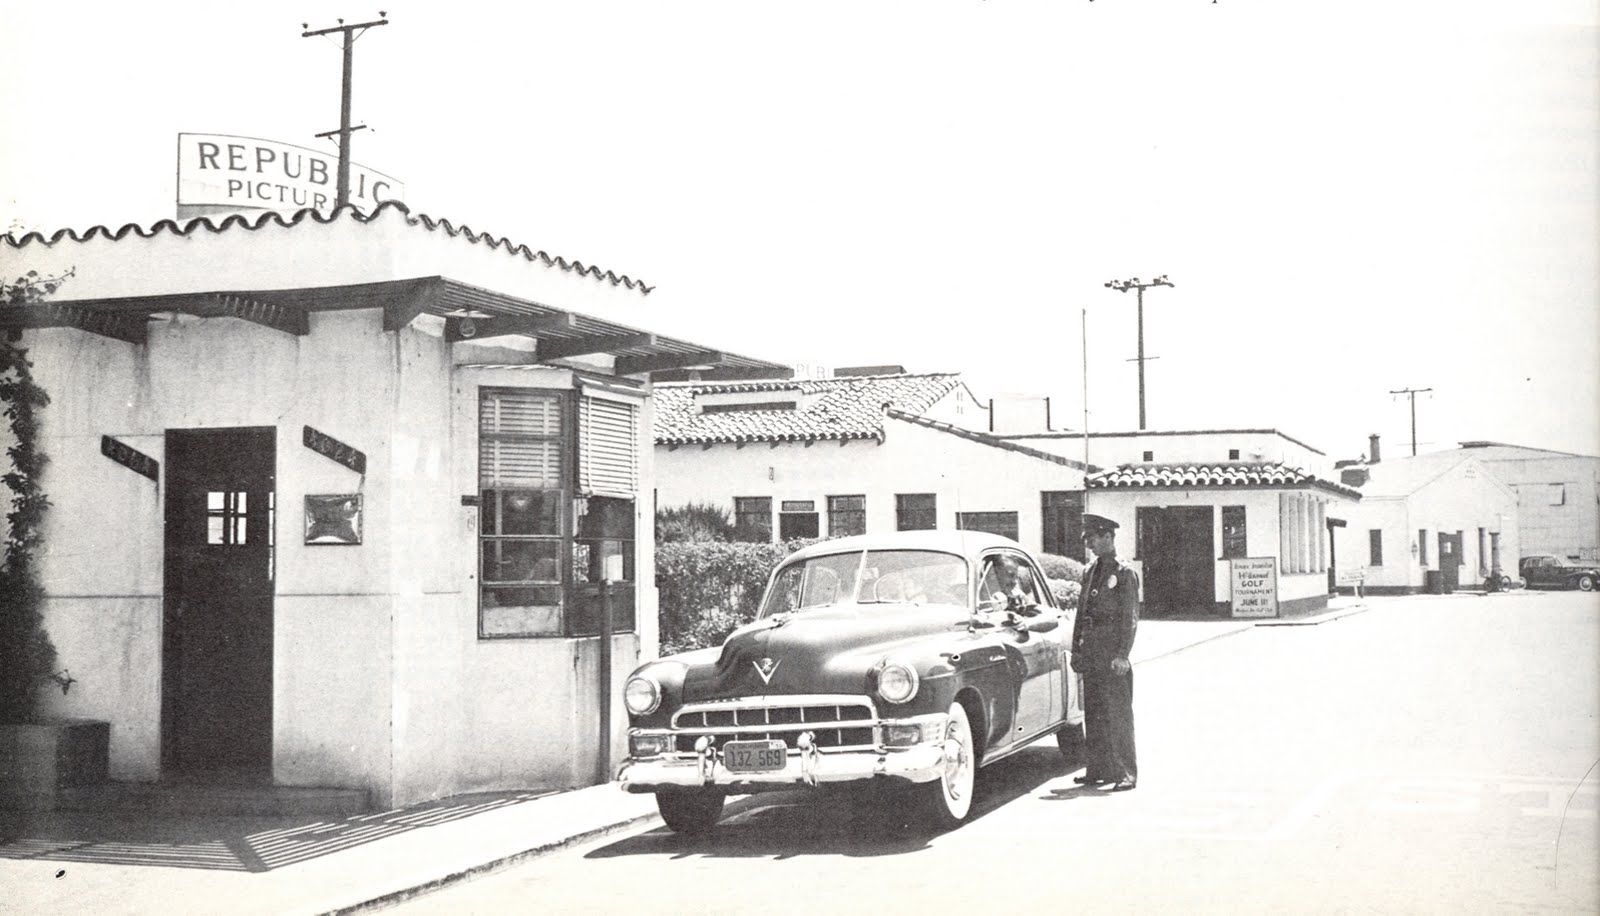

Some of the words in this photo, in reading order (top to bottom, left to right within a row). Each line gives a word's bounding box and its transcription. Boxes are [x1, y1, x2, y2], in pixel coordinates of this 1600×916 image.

[197, 142, 391, 204] REPUBIC
[227, 178, 365, 211] PICTUR
[758, 749, 781, 767] 569
